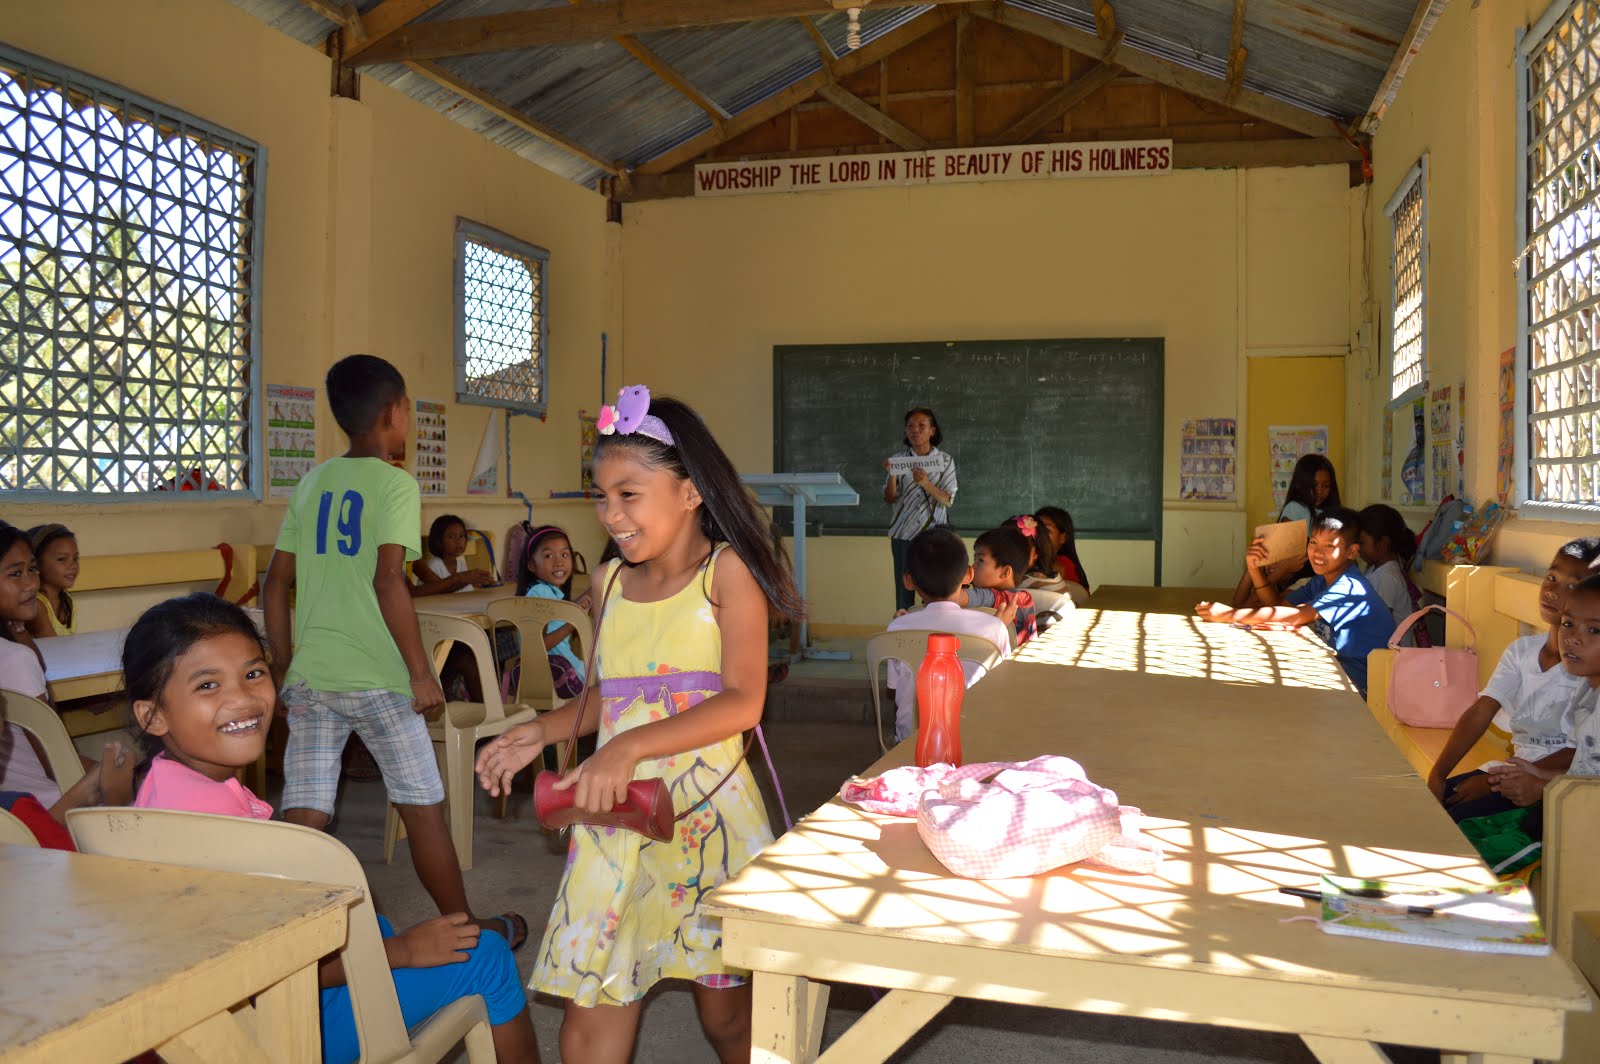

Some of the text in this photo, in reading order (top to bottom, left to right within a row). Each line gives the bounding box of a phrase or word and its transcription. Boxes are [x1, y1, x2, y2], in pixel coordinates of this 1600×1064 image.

[698, 146, 1170, 191] WORSHIP THE LORD IN THE BEAUTY OF HIS HOLINESS
[890, 459, 940, 470] repugnant
[316, 489, 365, 557] 19
